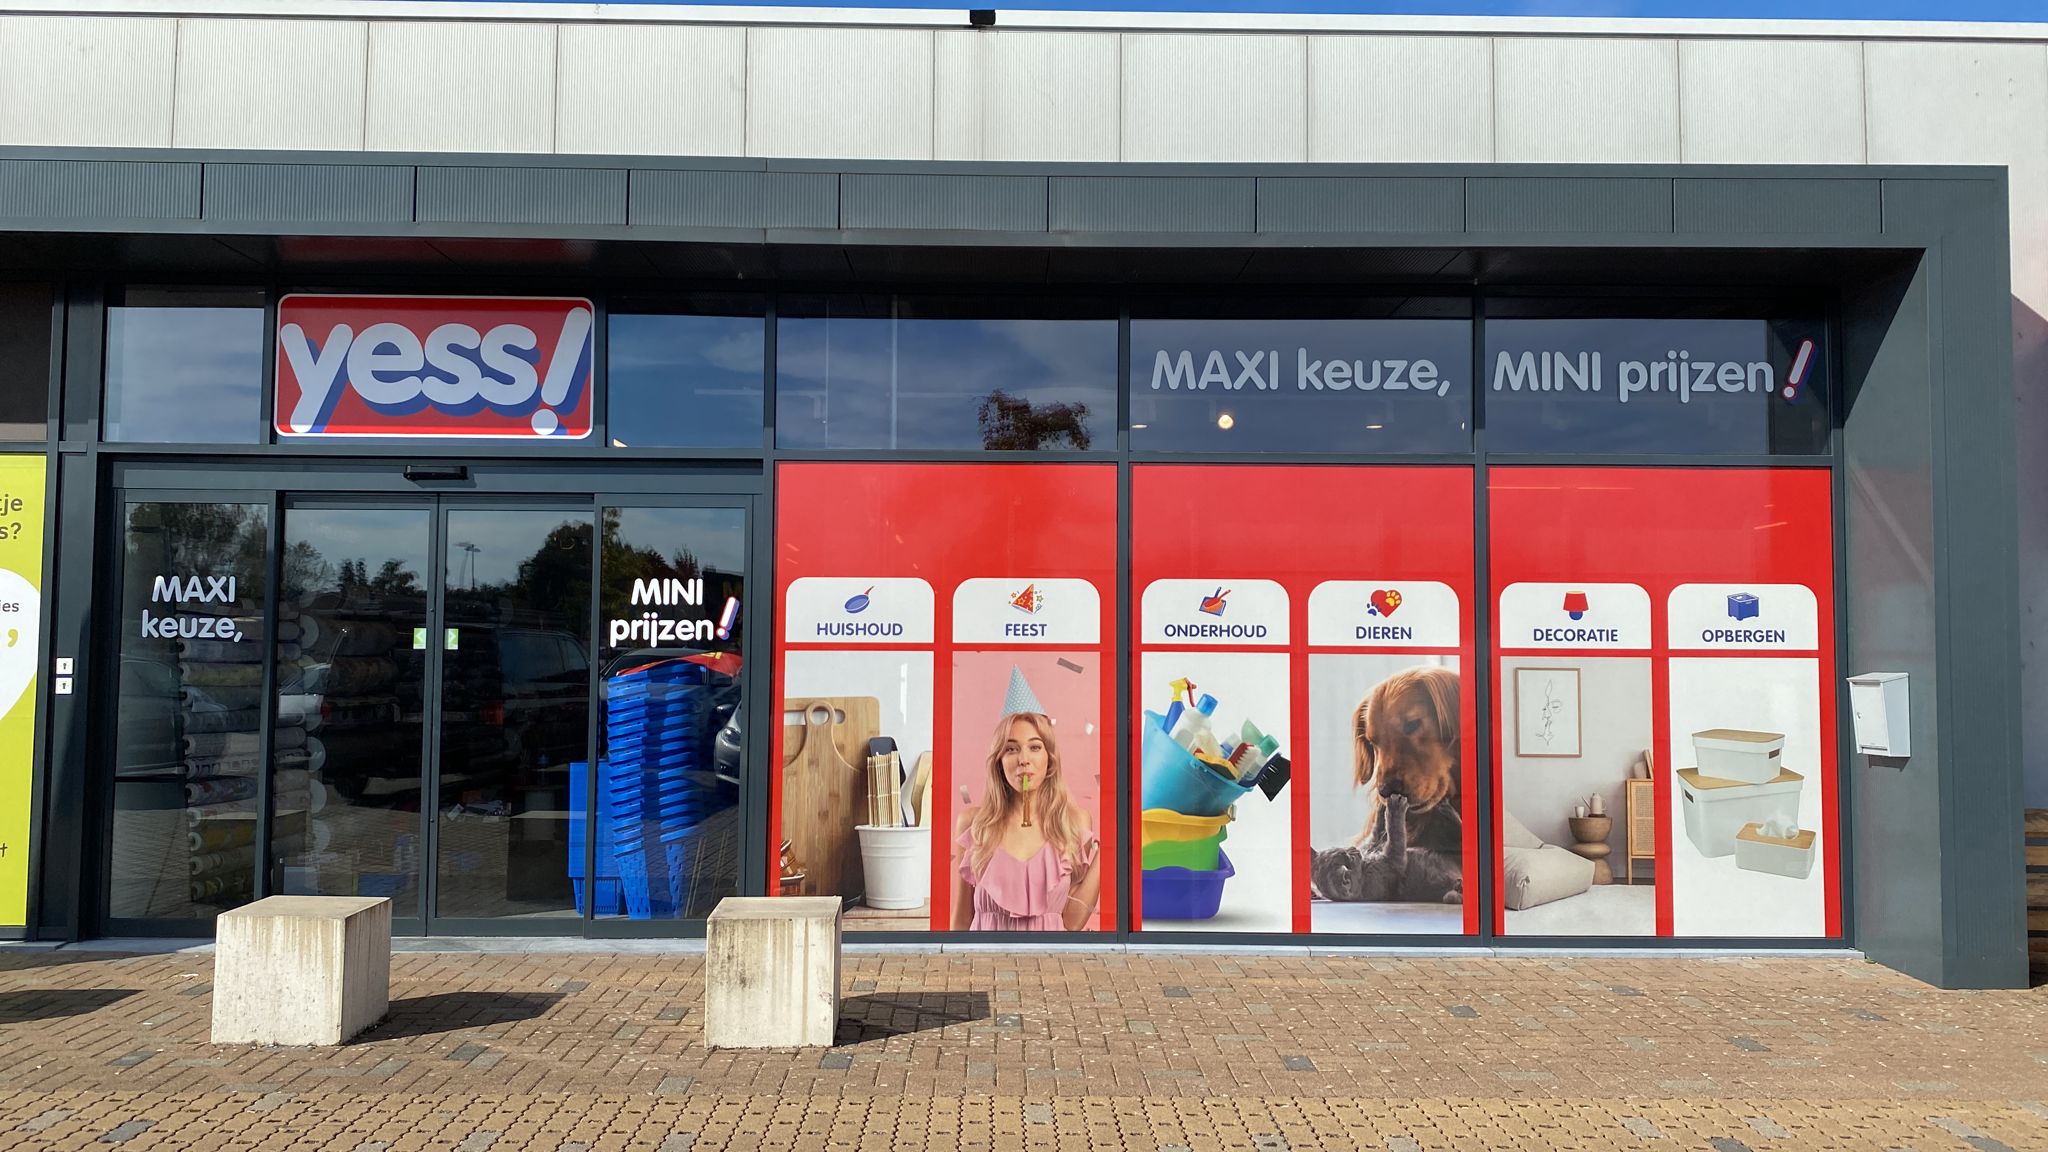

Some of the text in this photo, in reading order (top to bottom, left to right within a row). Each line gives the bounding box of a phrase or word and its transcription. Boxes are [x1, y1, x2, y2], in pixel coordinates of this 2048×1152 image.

[280, 307, 591, 436] yess!
[1151, 347, 1450, 397] MAXI keuze,
[1493, 351, 1601, 391] MINI
[0, 493, 23, 516] je
[151, 575, 236, 603] MAXI
[630, 578, 704, 606] MINI
[0, 599, 20, 613] es
[141, 609, 243, 643] keuze,
[816, 622, 904, 637] HUISHOUD
[1004, 623, 1048, 637] FEEST
[1164, 623, 1267, 638] ONDERHOUD
[1355, 626, 1413, 640] DIEREN
[1533, 628, 1619, 642] DECORATIE
[1701, 629, 1786, 643] OPBERGEN
